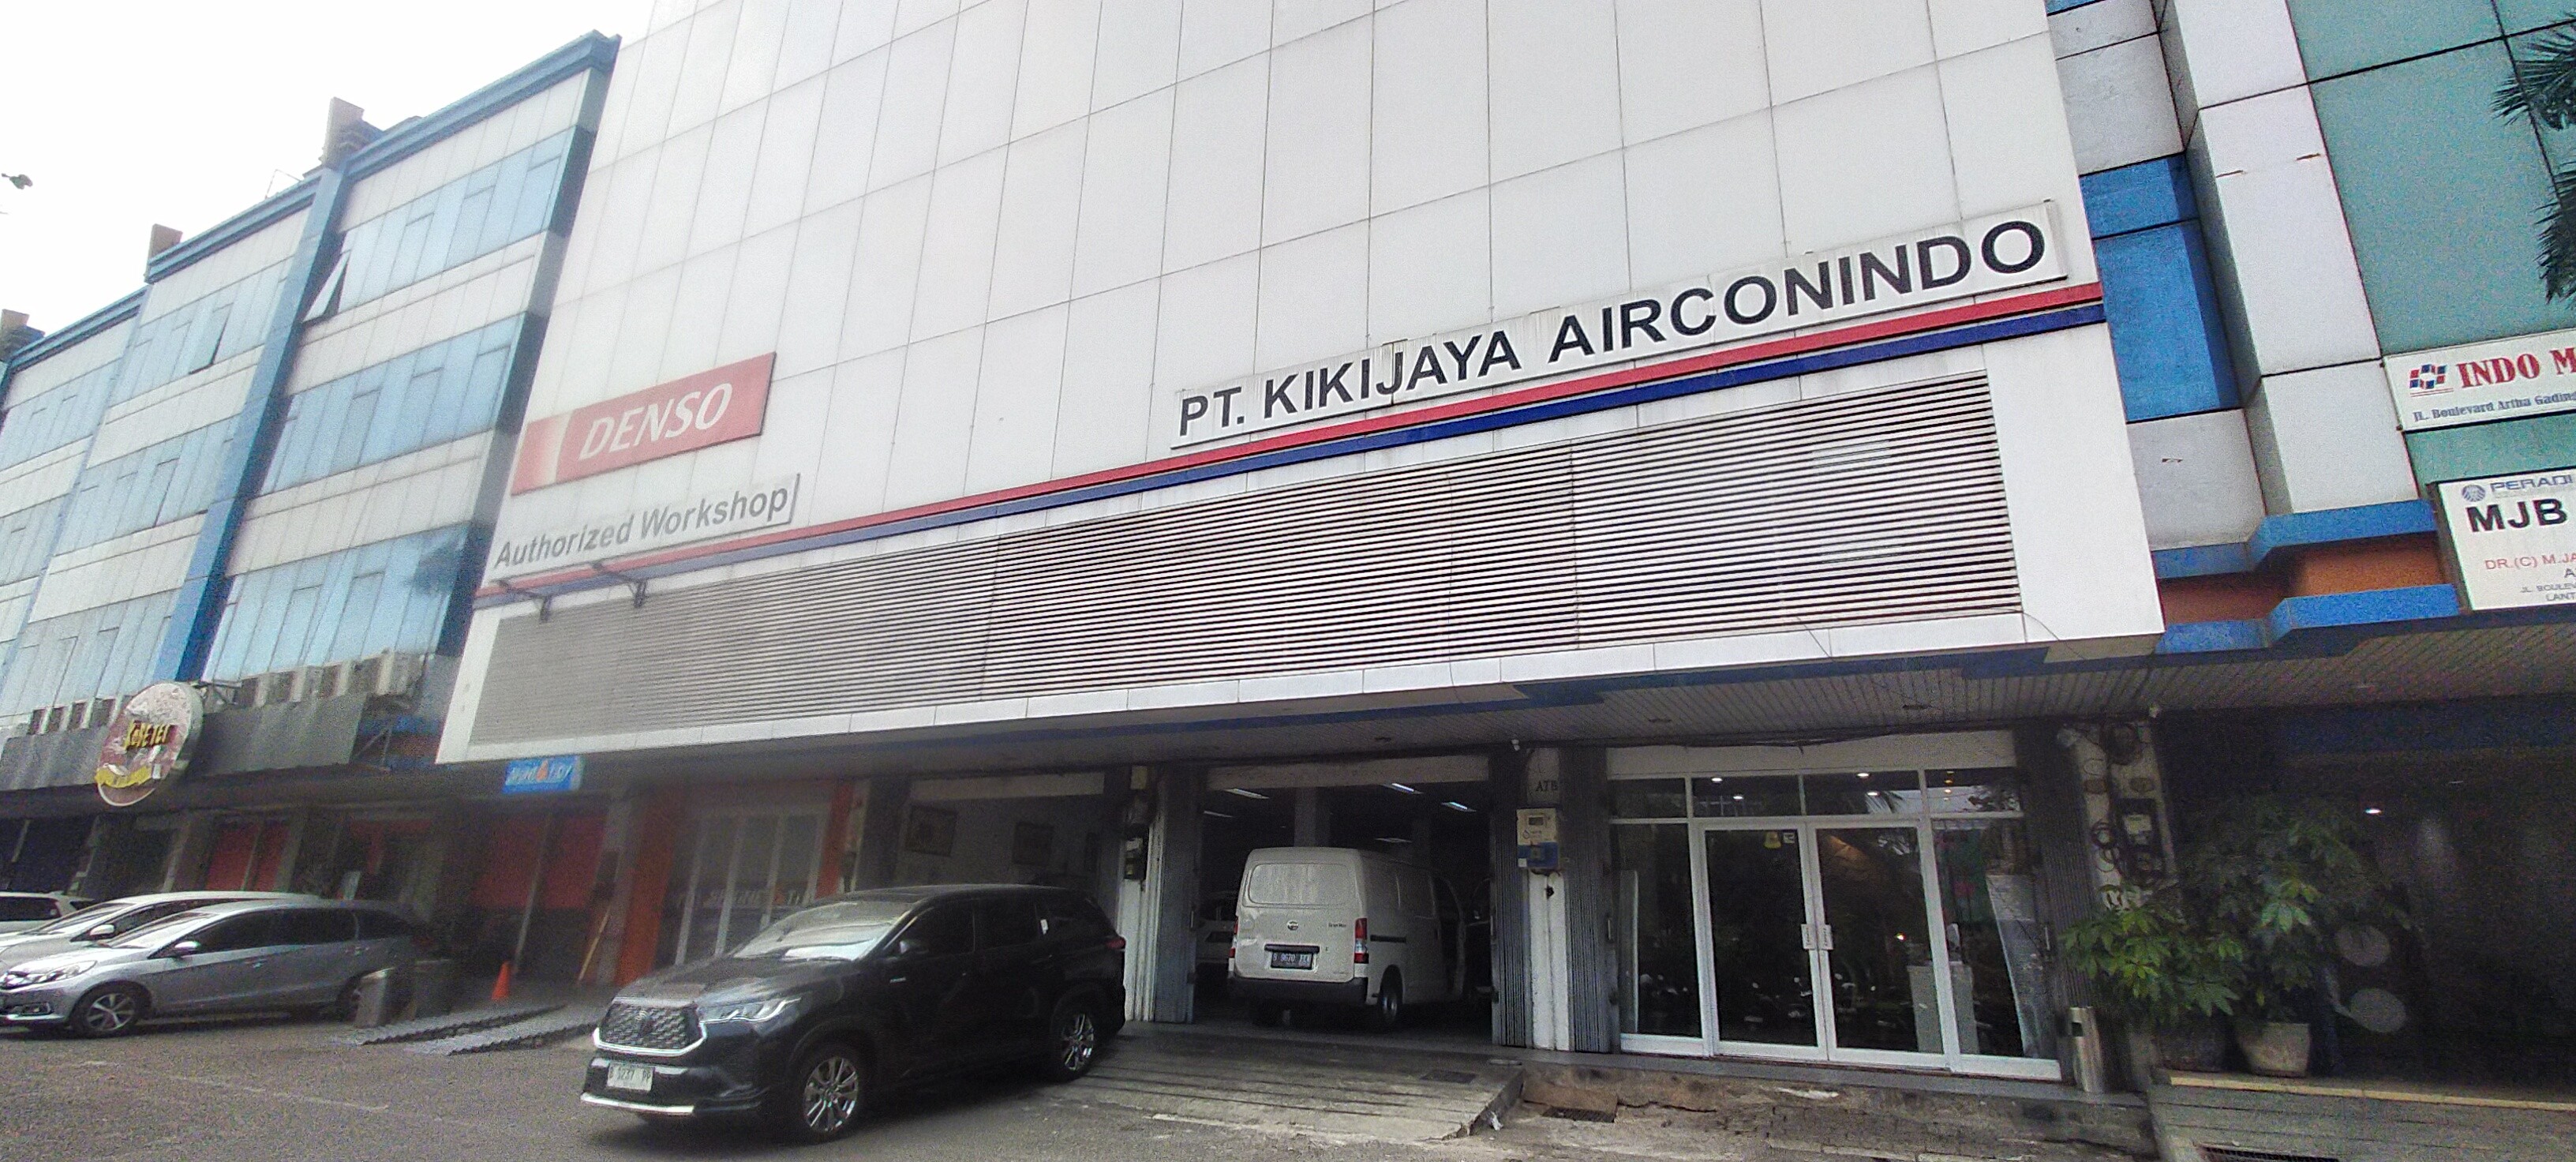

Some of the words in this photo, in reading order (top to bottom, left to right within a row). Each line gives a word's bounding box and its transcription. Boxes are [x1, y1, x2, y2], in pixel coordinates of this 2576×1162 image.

[1179, 387, 1245, 437] PT.
[1264, 330, 1522, 419] KIKIJAYA
[1548, 219, 2046, 364] AIRCONINDO
[2456, 353, 2540, 388] INDO
[577, 383, 733, 461] DENSO
[2432, 402, 2495, 418] Boulevard
[2490, 474, 2574, 493] PERADI
[494, 513, 634, 568] Authorized
[642, 486, 788, 539] Workshop
[2466, 498, 2568, 533] MJB
